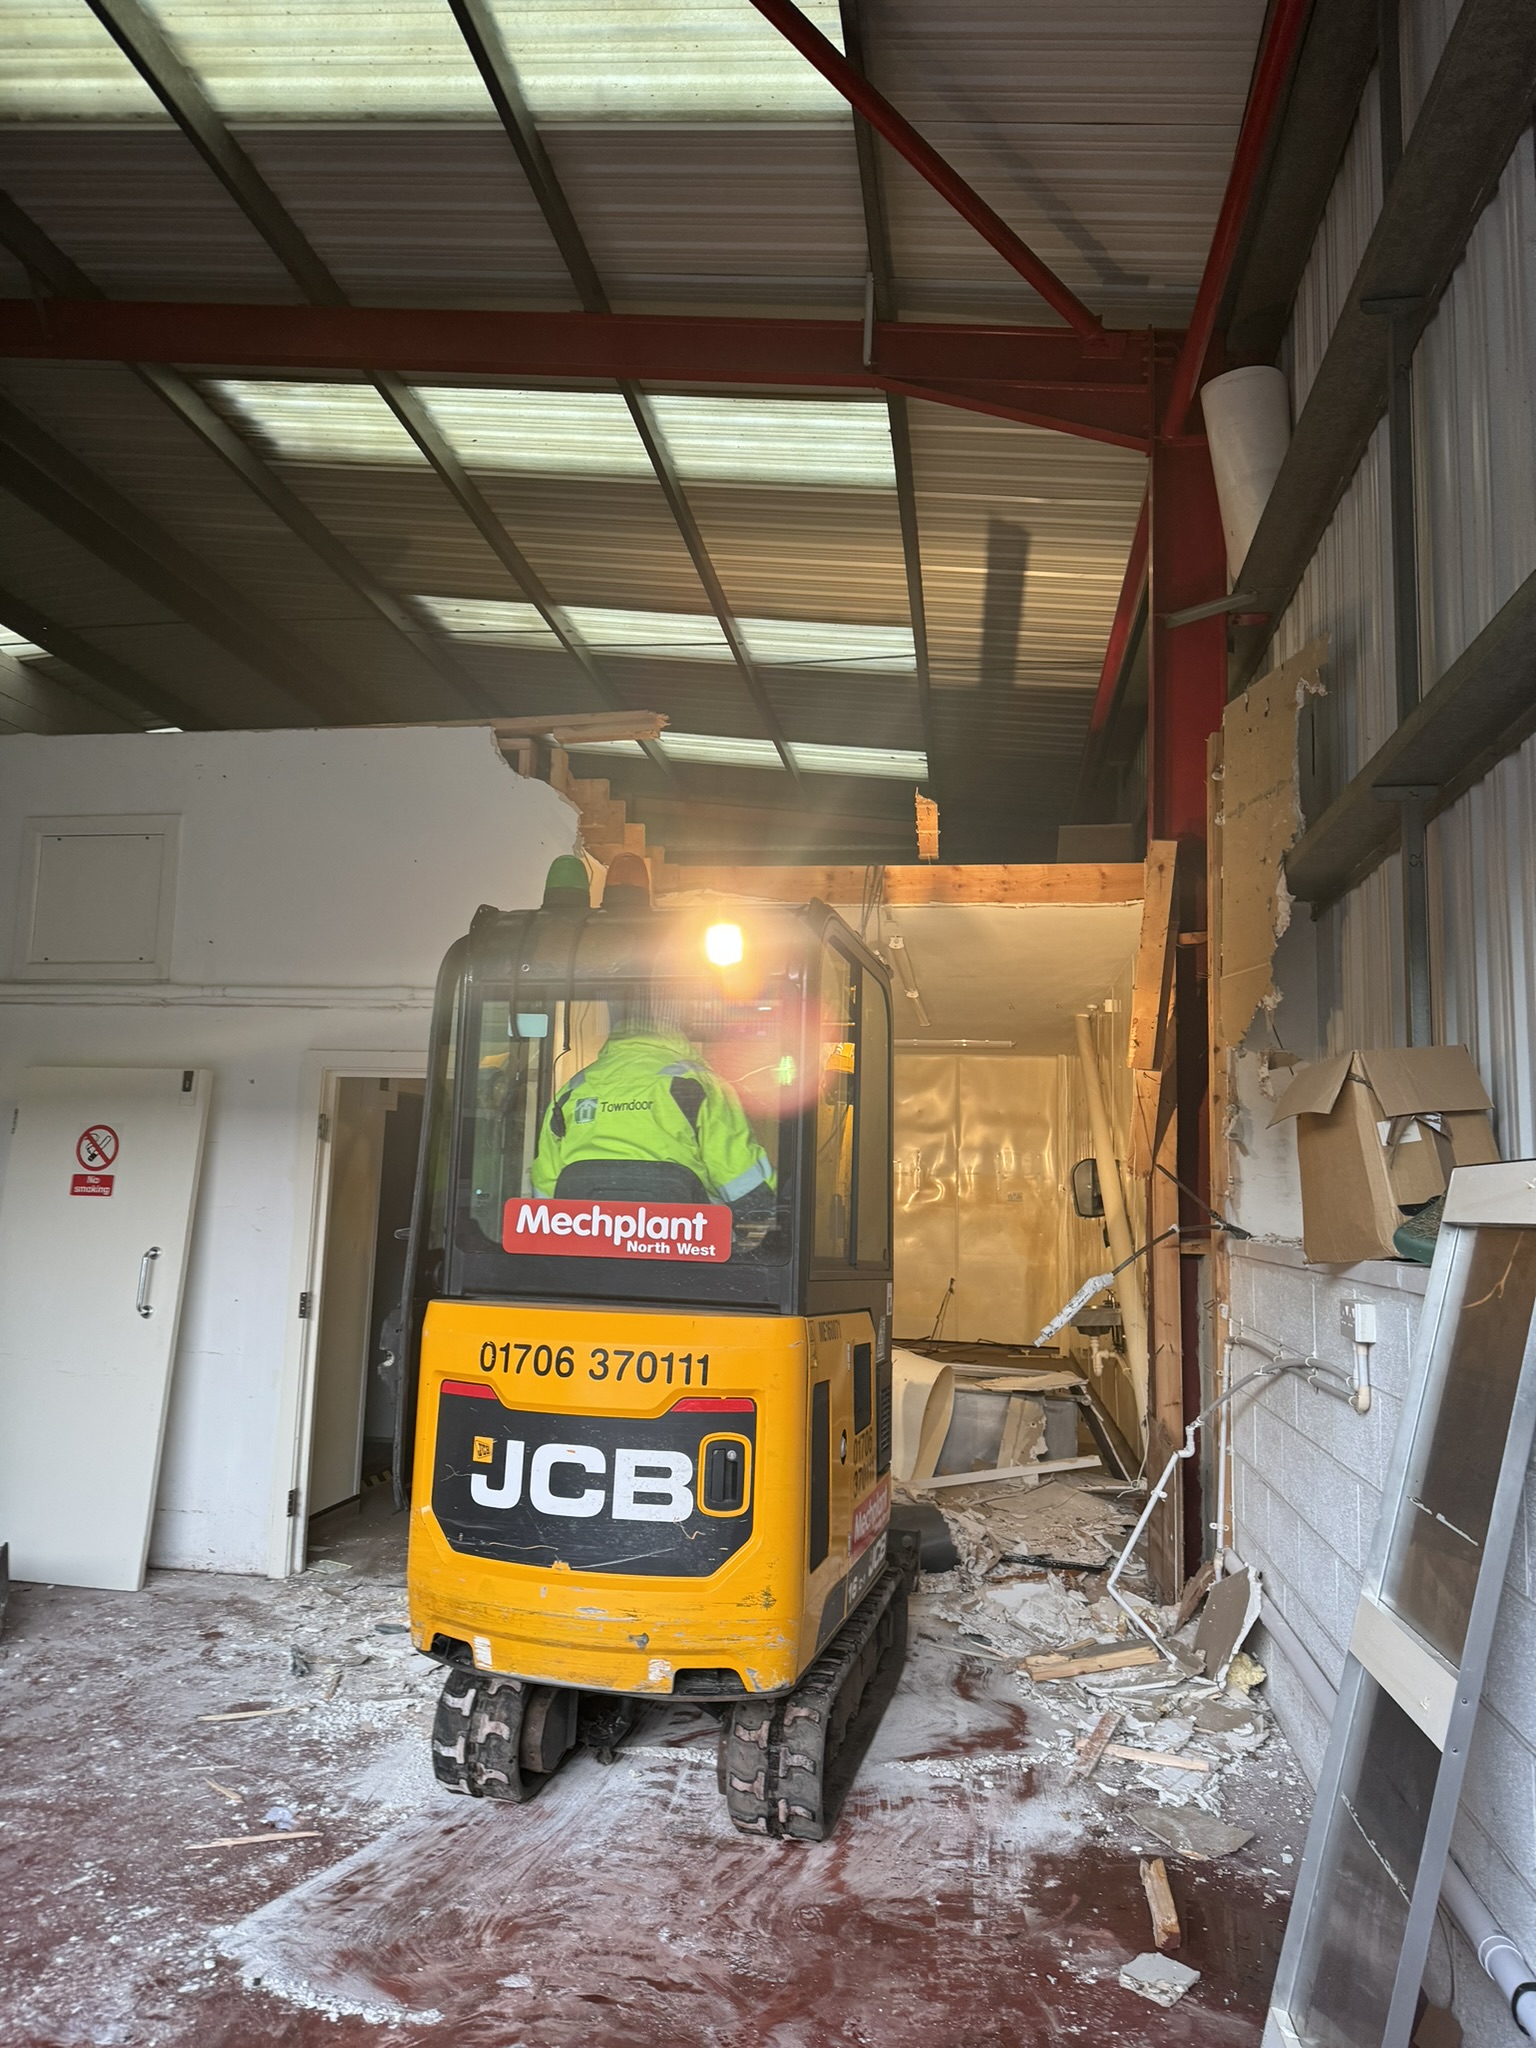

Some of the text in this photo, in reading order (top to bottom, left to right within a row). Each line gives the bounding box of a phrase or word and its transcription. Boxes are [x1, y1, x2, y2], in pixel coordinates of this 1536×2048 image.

[600, 1099, 653, 1113] Towndoor
[86, 1176, 100, 1184] No
[73, 1185, 111, 1195] smoking
[516, 1204, 708, 1246] Mechplant
[626, 1240, 716, 1257] North West
[479, 1341, 710, 1386] 01706 370111
[470, 1439, 694, 1523] JCB
